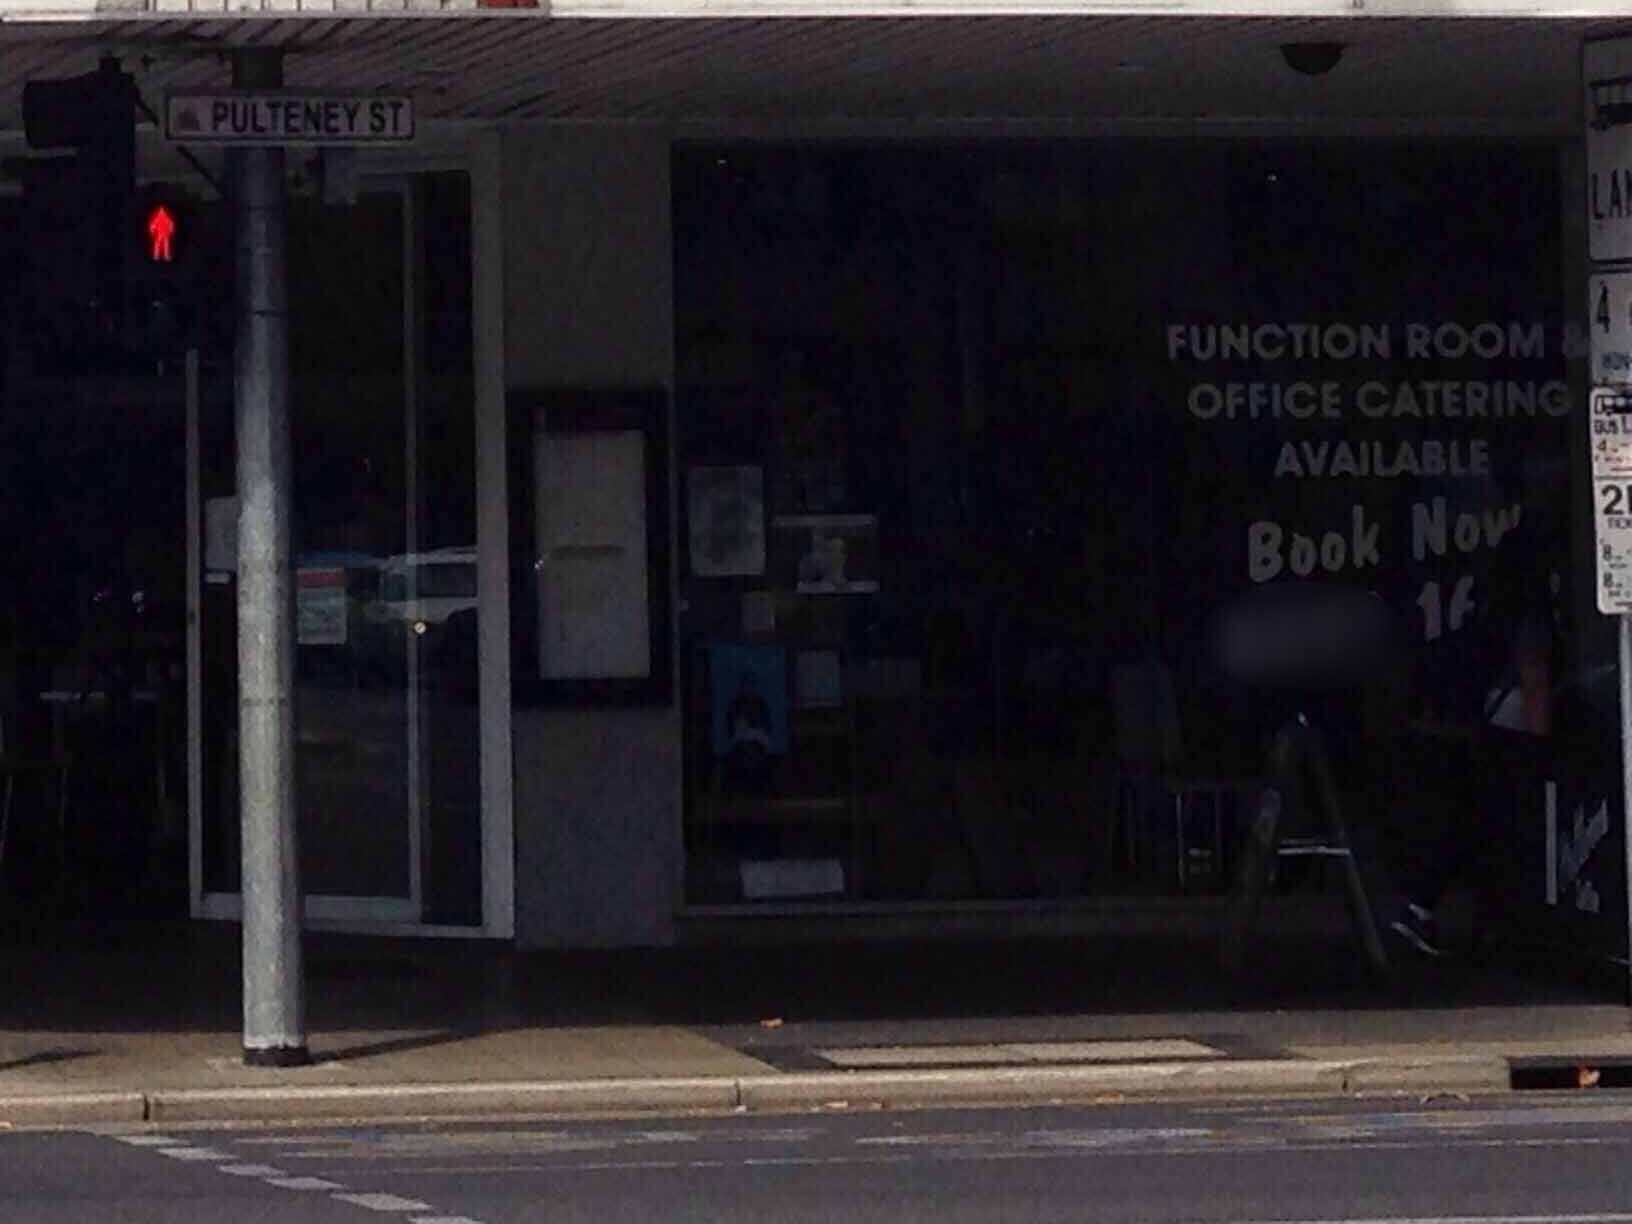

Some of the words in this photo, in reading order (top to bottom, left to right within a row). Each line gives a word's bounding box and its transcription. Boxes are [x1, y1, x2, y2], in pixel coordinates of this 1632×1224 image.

[212, 100, 361, 135] PULTENEY
[371, 100, 404, 133] ST
[1167, 322, 1391, 361] FUNCTION
[1406, 321, 1545, 361] ROOM
[1187, 381, 1343, 420] OFFICE
[1355, 379, 1575, 418] CATERING
[1273, 439, 1490, 479] AVAILABLE
[1247, 504, 1381, 584] Book
[1410, 495, 1521, 562] Now
